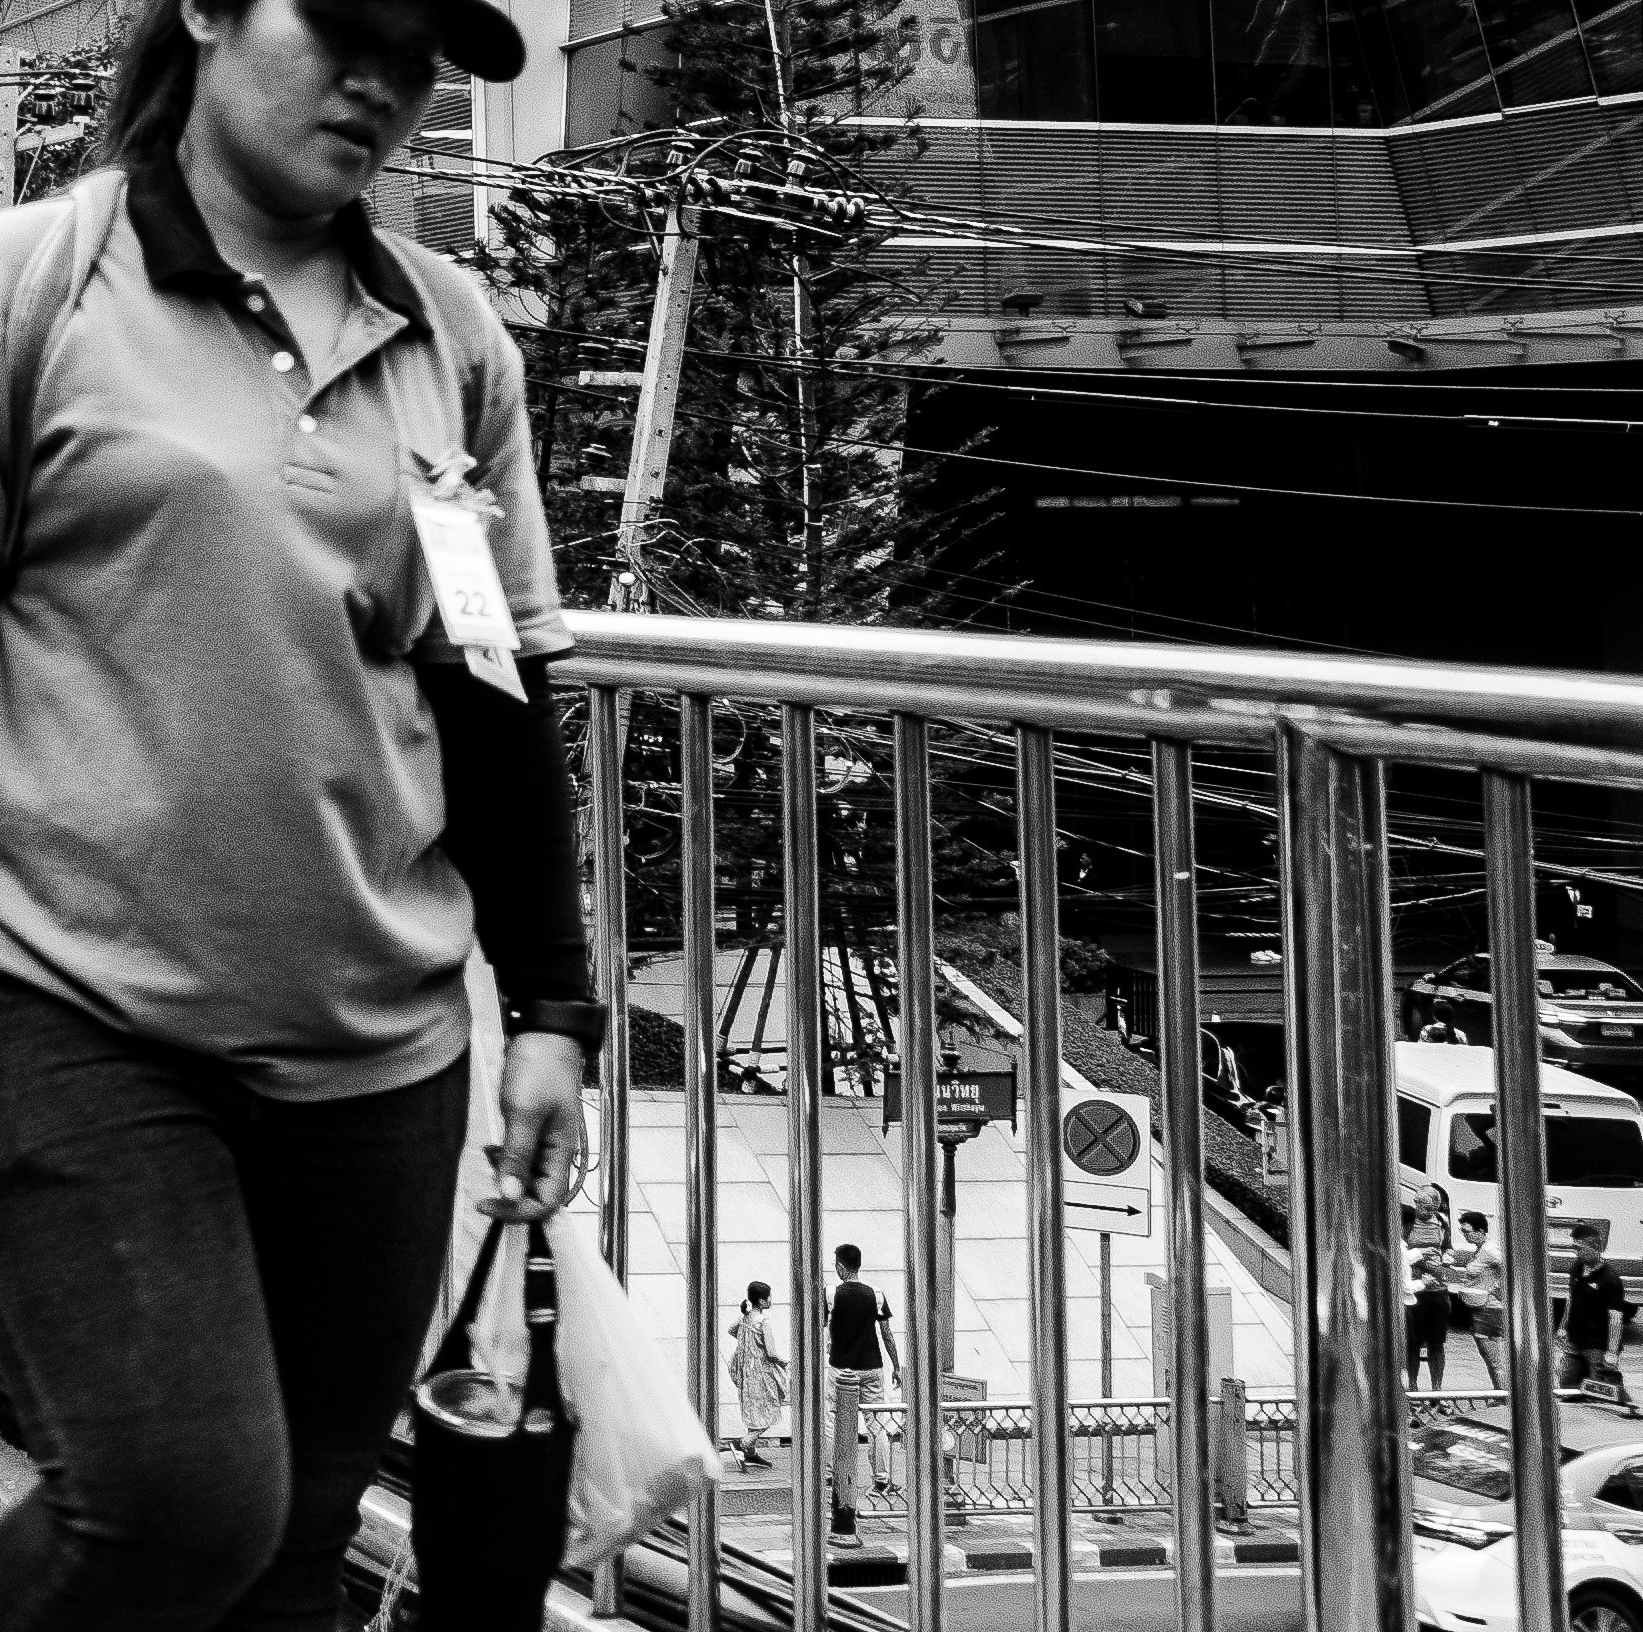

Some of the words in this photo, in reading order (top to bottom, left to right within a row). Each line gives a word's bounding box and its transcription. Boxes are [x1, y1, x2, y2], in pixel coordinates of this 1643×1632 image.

[454, 588, 492, 618] 22
[936, 1079, 980, 1104] นวิทยุ
